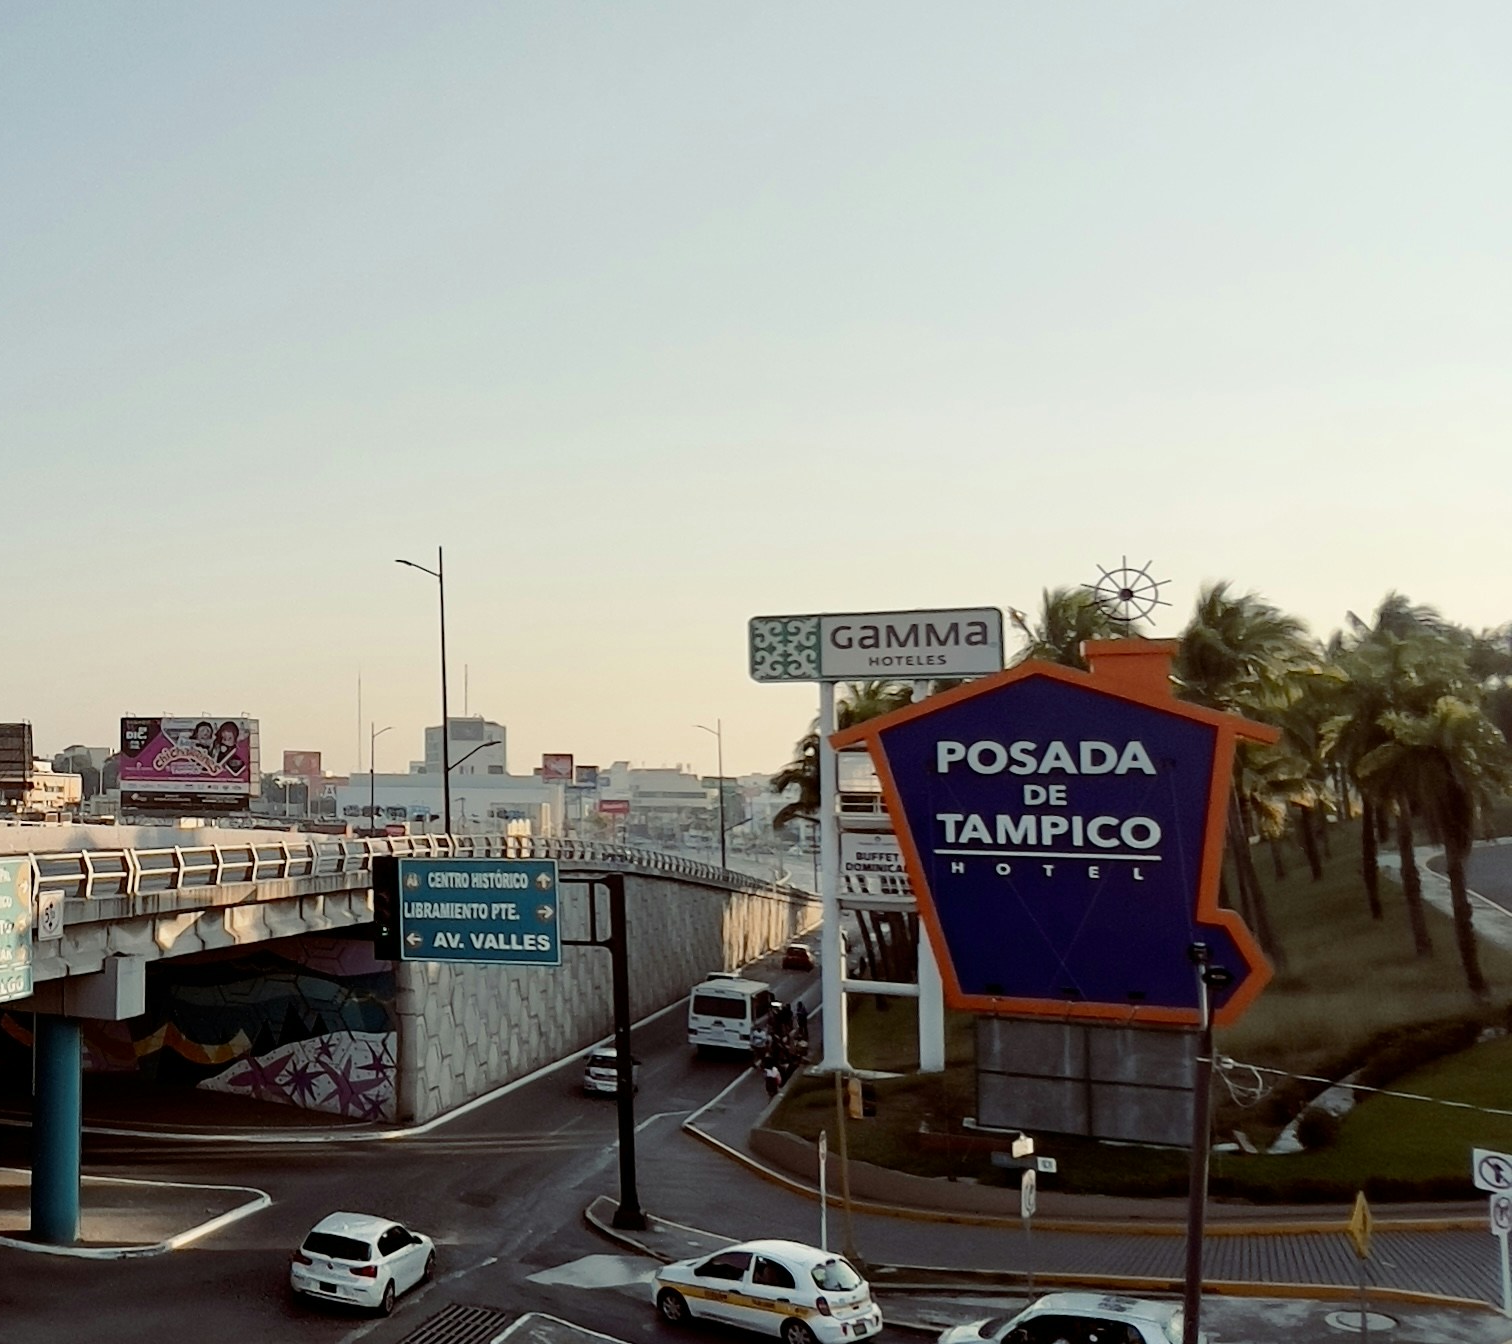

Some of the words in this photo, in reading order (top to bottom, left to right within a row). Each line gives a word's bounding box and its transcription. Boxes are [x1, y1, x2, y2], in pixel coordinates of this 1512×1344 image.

[868, 654, 947, 667] HOTELES
[936, 740, 1157, 776] POSADA
[1023, 784, 1068, 806] DE
[936, 813, 1162, 850] TAMPICO
[855, 851, 900, 862] BUFFET
[428, 871, 470, 889] CENTRO
[471, 868, 529, 889] HISTÓRICO
[950, 861, 1145, 881] HOTEL
[403, 901, 489, 920] LIBRAMIENTO
[491, 902, 521, 921] PTE.
[433, 931, 465, 949] AV.
[470, 932, 551, 952] VALLES
